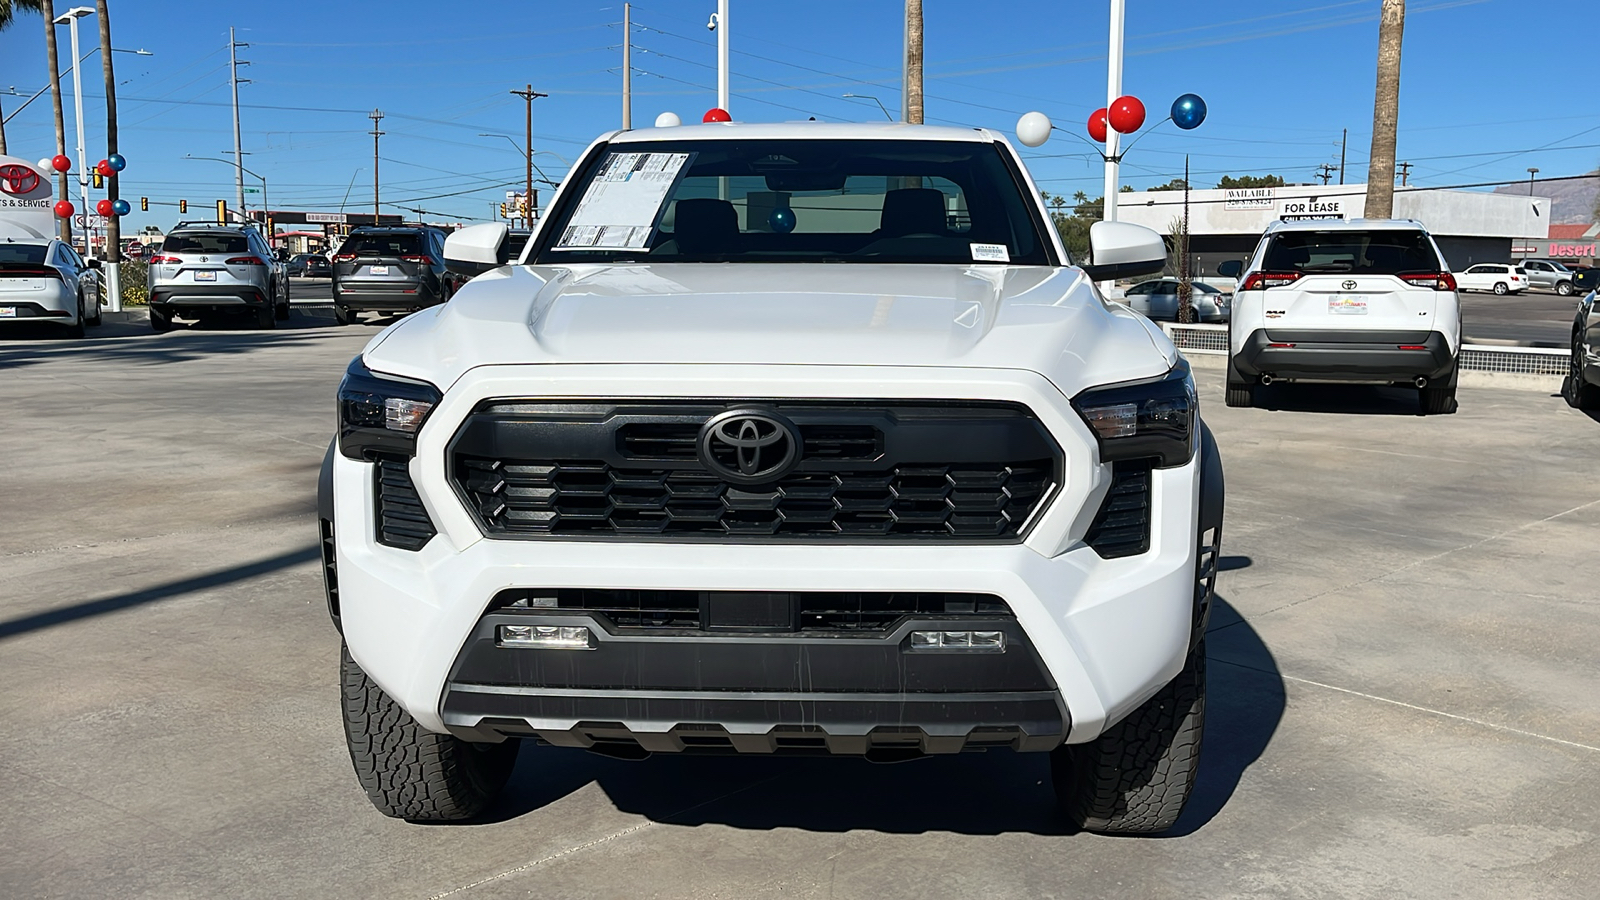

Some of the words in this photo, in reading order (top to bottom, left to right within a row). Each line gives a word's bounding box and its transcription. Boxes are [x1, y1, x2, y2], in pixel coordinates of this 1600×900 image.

[9, 199, 16, 207] &
[17, 199, 51, 208] SERVICE
[1285, 203, 1306, 213] FOR
[1308, 202, 1340, 213] LEASE
[1549, 243, 1596, 257] Desert
